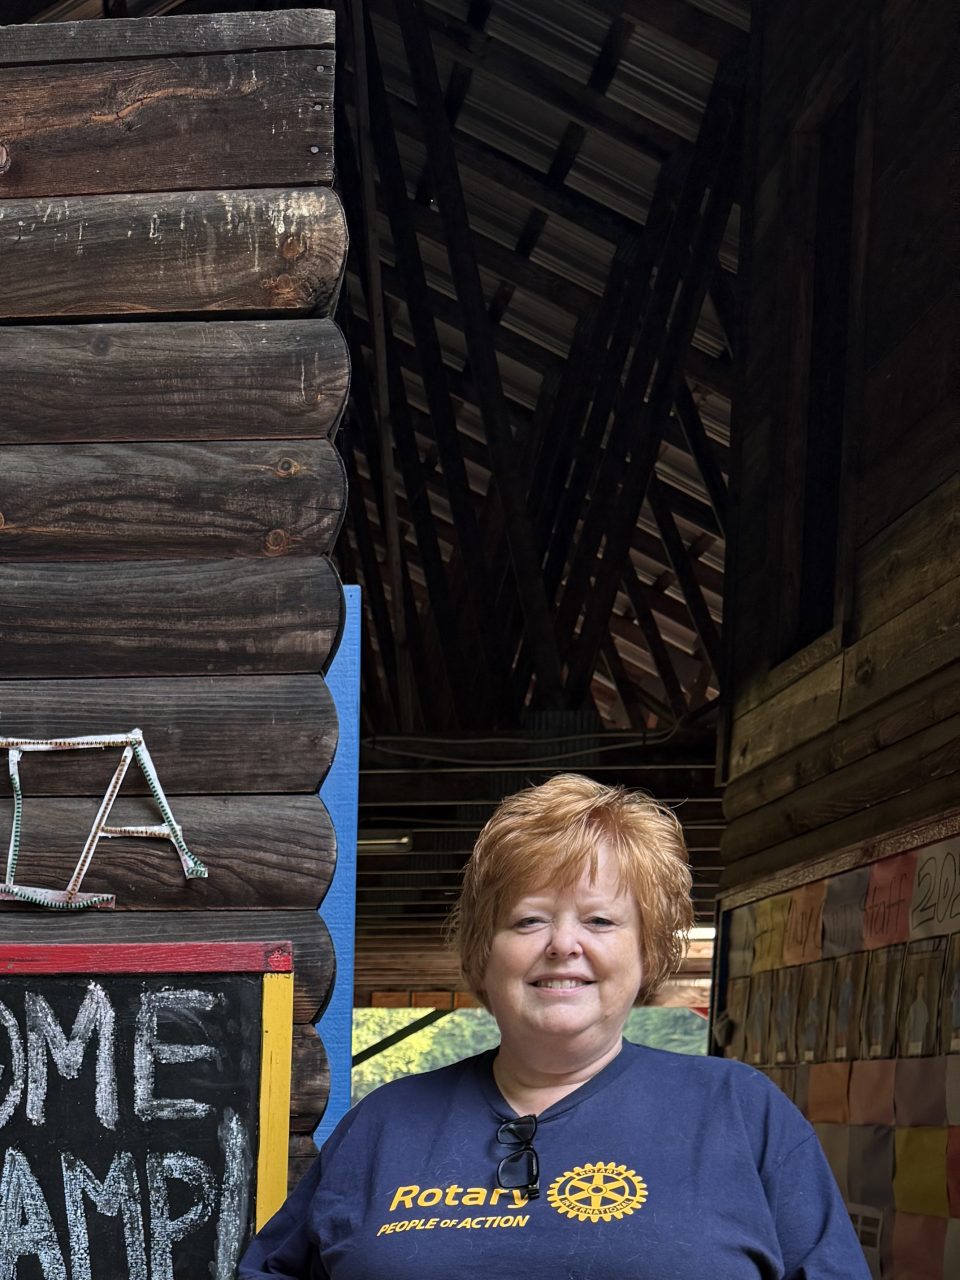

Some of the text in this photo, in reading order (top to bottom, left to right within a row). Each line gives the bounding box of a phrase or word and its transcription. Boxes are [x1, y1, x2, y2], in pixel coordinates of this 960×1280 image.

[580, 1168, 621, 1177] ROTARY
[390, 1184, 529, 1211] Rotary
[561, 1198, 634, 1216] INTERNATIONAL
[376, 1217, 439, 1237] PEOPLE
[457, 1214, 530, 1229] ACTION
